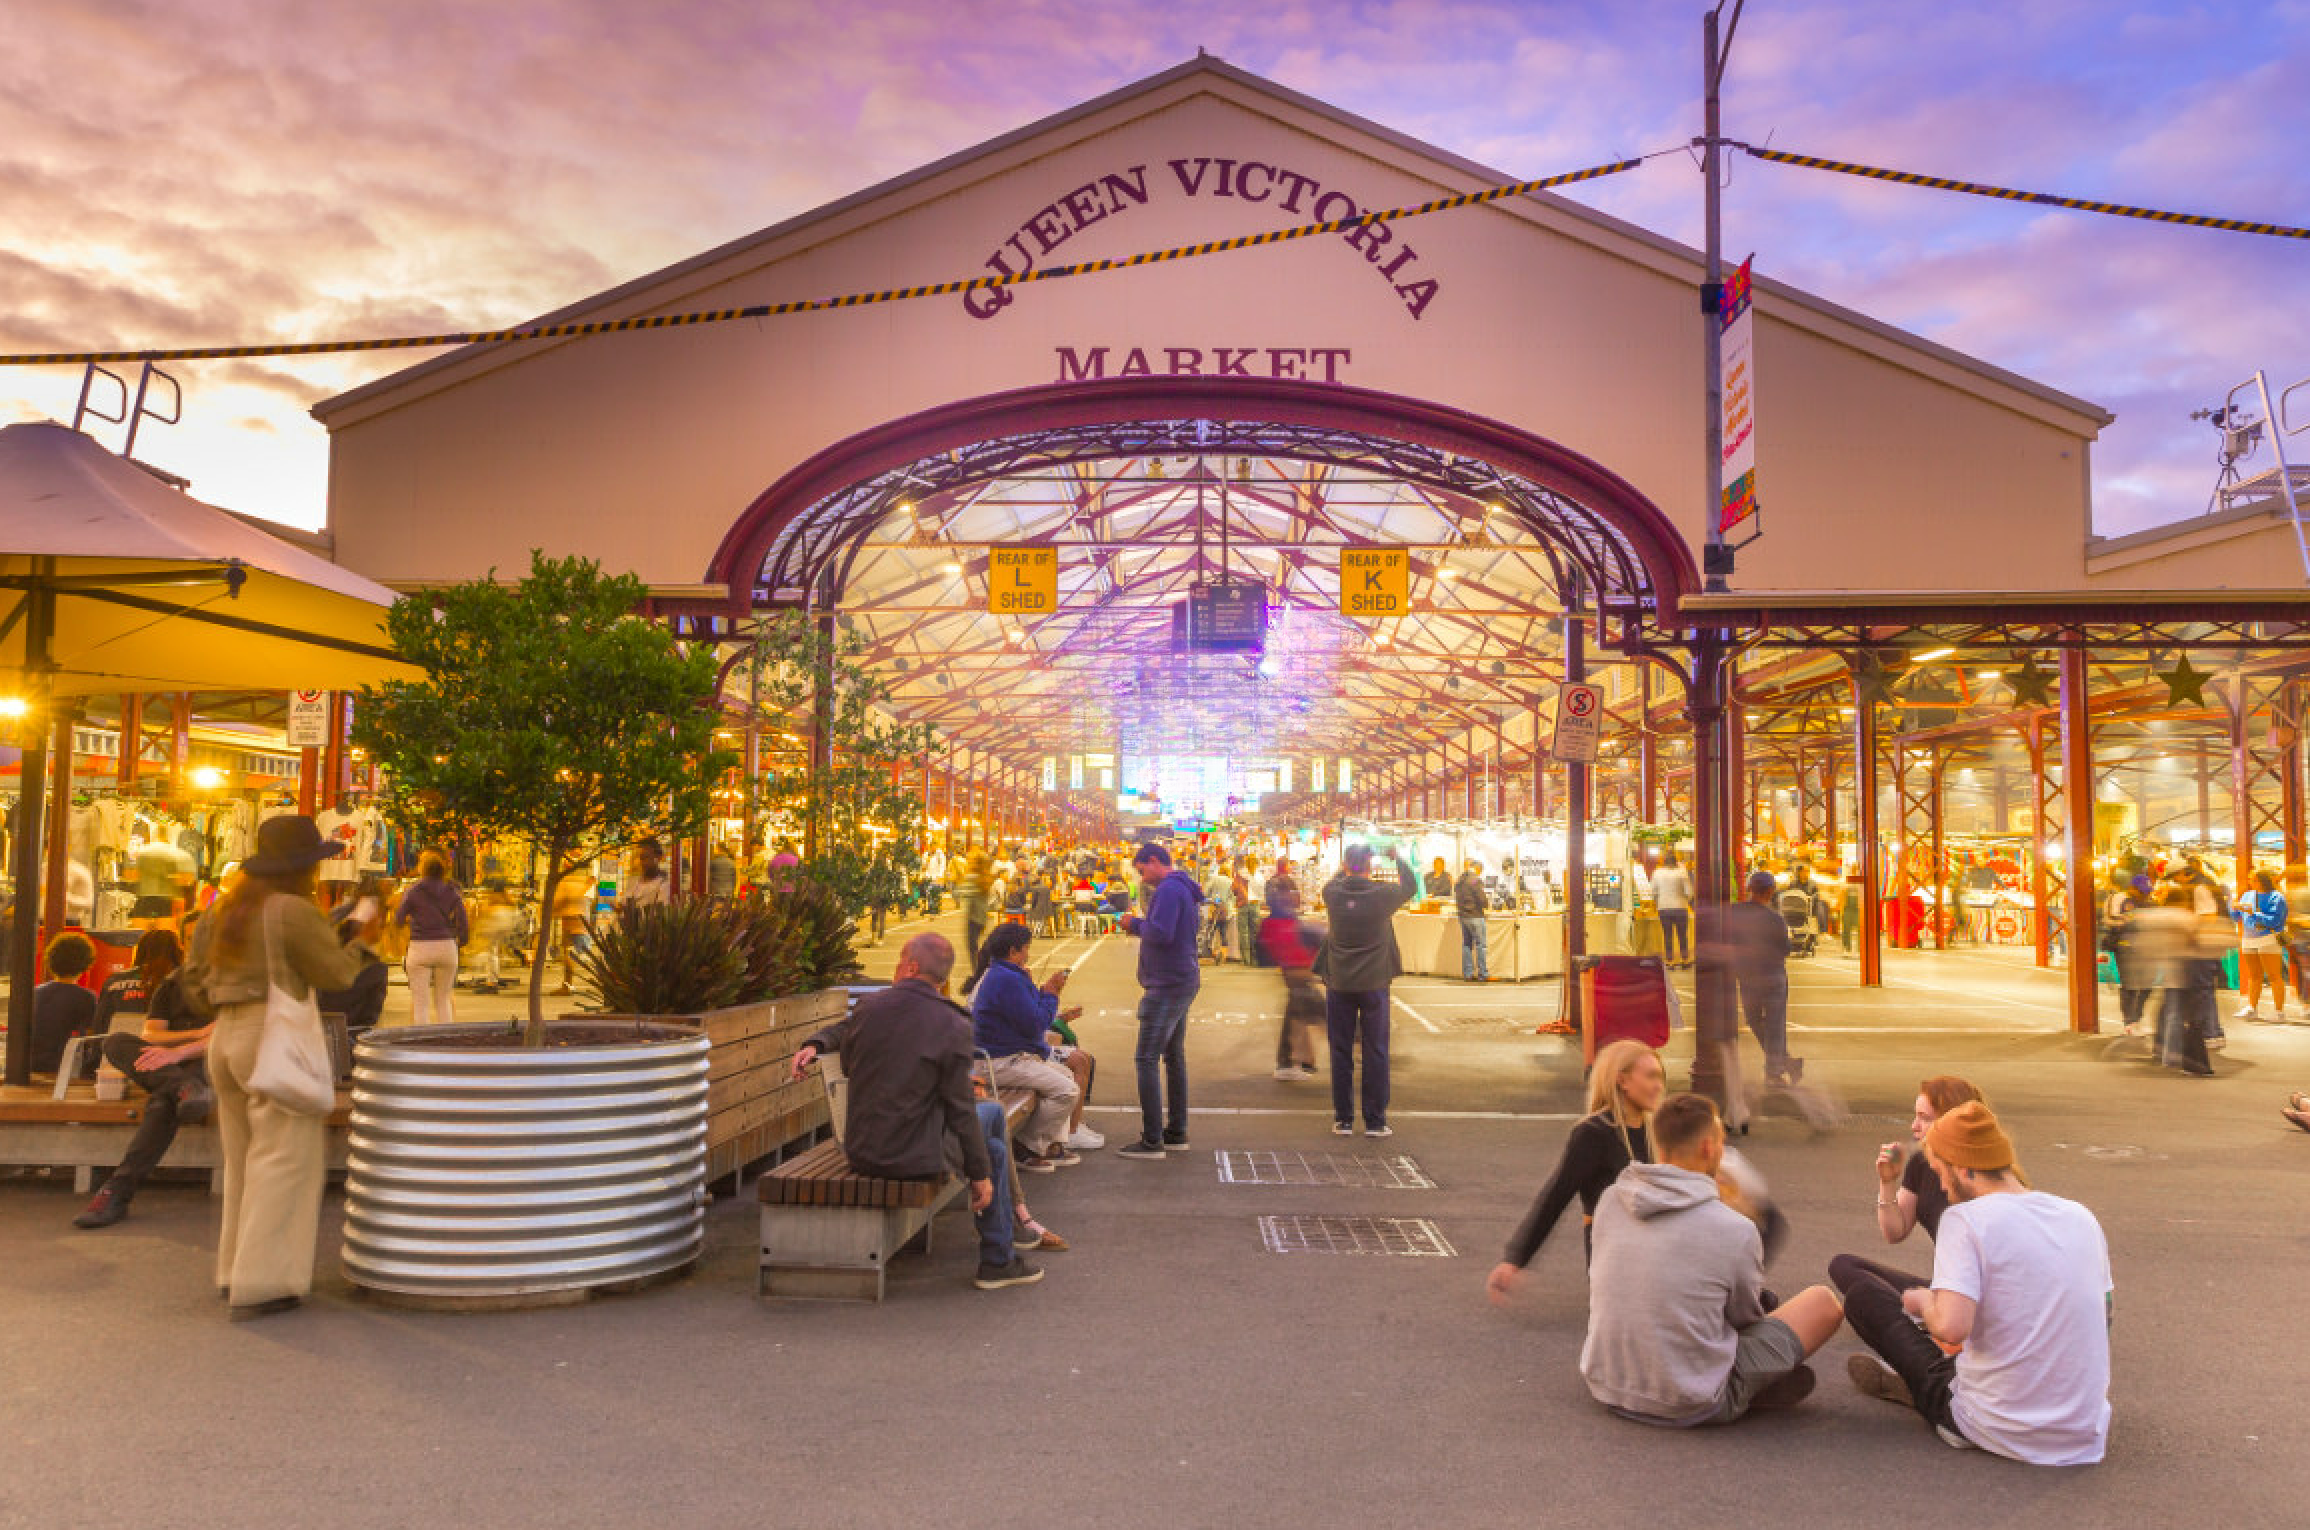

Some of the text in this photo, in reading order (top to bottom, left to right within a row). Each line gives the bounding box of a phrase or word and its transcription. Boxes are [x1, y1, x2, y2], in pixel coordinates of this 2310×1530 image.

[963, 157, 1440, 320] QUEEN VICTORIA
[1055, 347, 1351, 385] MARKET
[997, 553, 1049, 566] REAR OF
[1347, 554, 1399, 567] REAR OF
[1016, 567, 1032, 586] L
[1365, 570, 1383, 590] K
[1001, 592, 1045, 609] SHED
[1351, 594, 1396, 611] SHED
